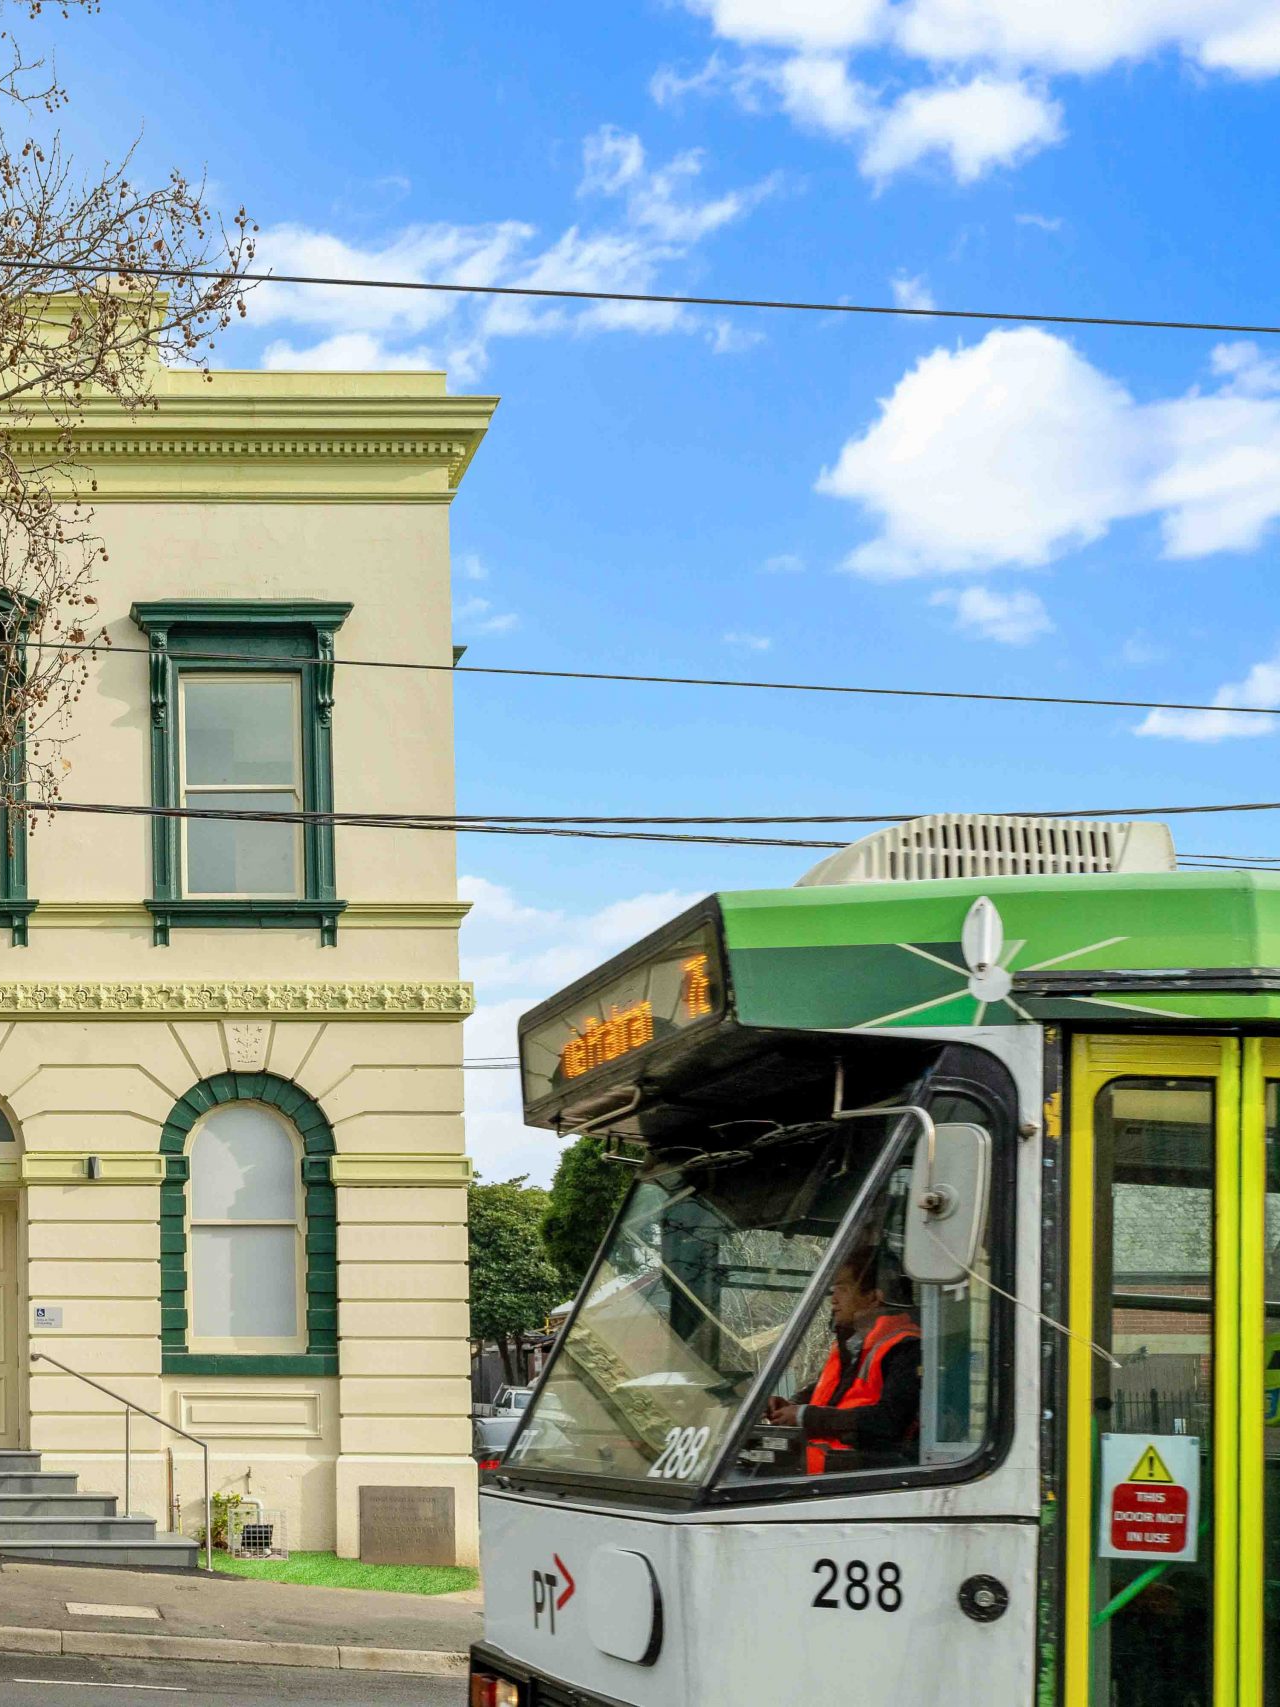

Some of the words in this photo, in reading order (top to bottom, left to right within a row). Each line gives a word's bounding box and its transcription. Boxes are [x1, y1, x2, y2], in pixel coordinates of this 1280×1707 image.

[646, 1426, 710, 1479] 288
[1134, 1491, 1166, 1503] THIS
[1114, 1511, 1154, 1522] DOOR
[1155, 1513, 1185, 1524] NOT
[1126, 1531, 1142, 1542] IN
[1144, 1532, 1171, 1544] USE
[811, 1558, 903, 1613] 288
